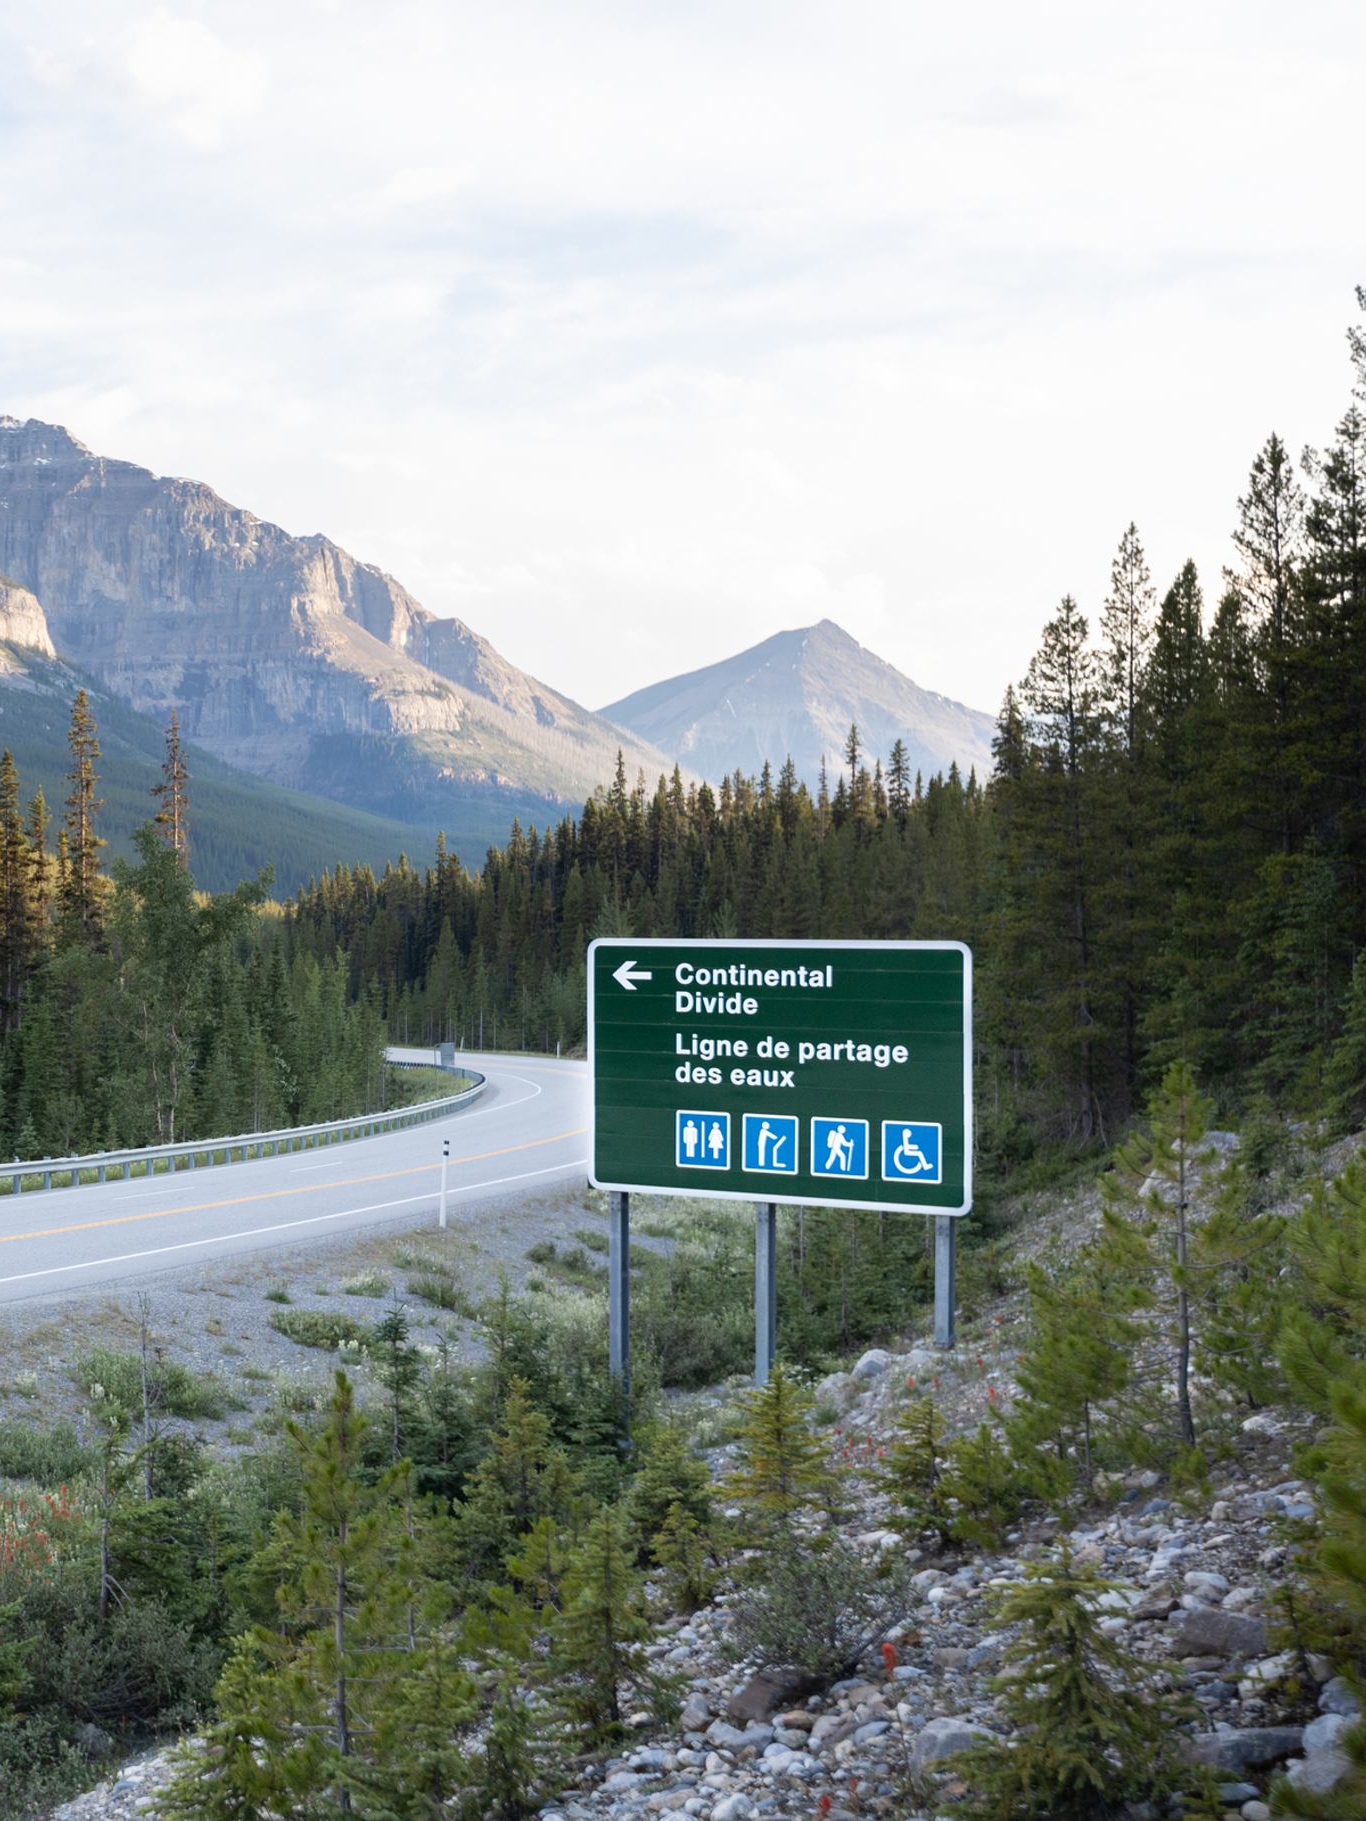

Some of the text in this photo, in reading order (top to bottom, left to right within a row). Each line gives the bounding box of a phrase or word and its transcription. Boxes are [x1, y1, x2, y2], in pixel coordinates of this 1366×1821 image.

[676, 963, 832, 987] Continental
[676, 991, 758, 1014] Divide
[676, 1033, 908, 1067] Ligne de partage
[676, 1062, 795, 1087] des eaux
